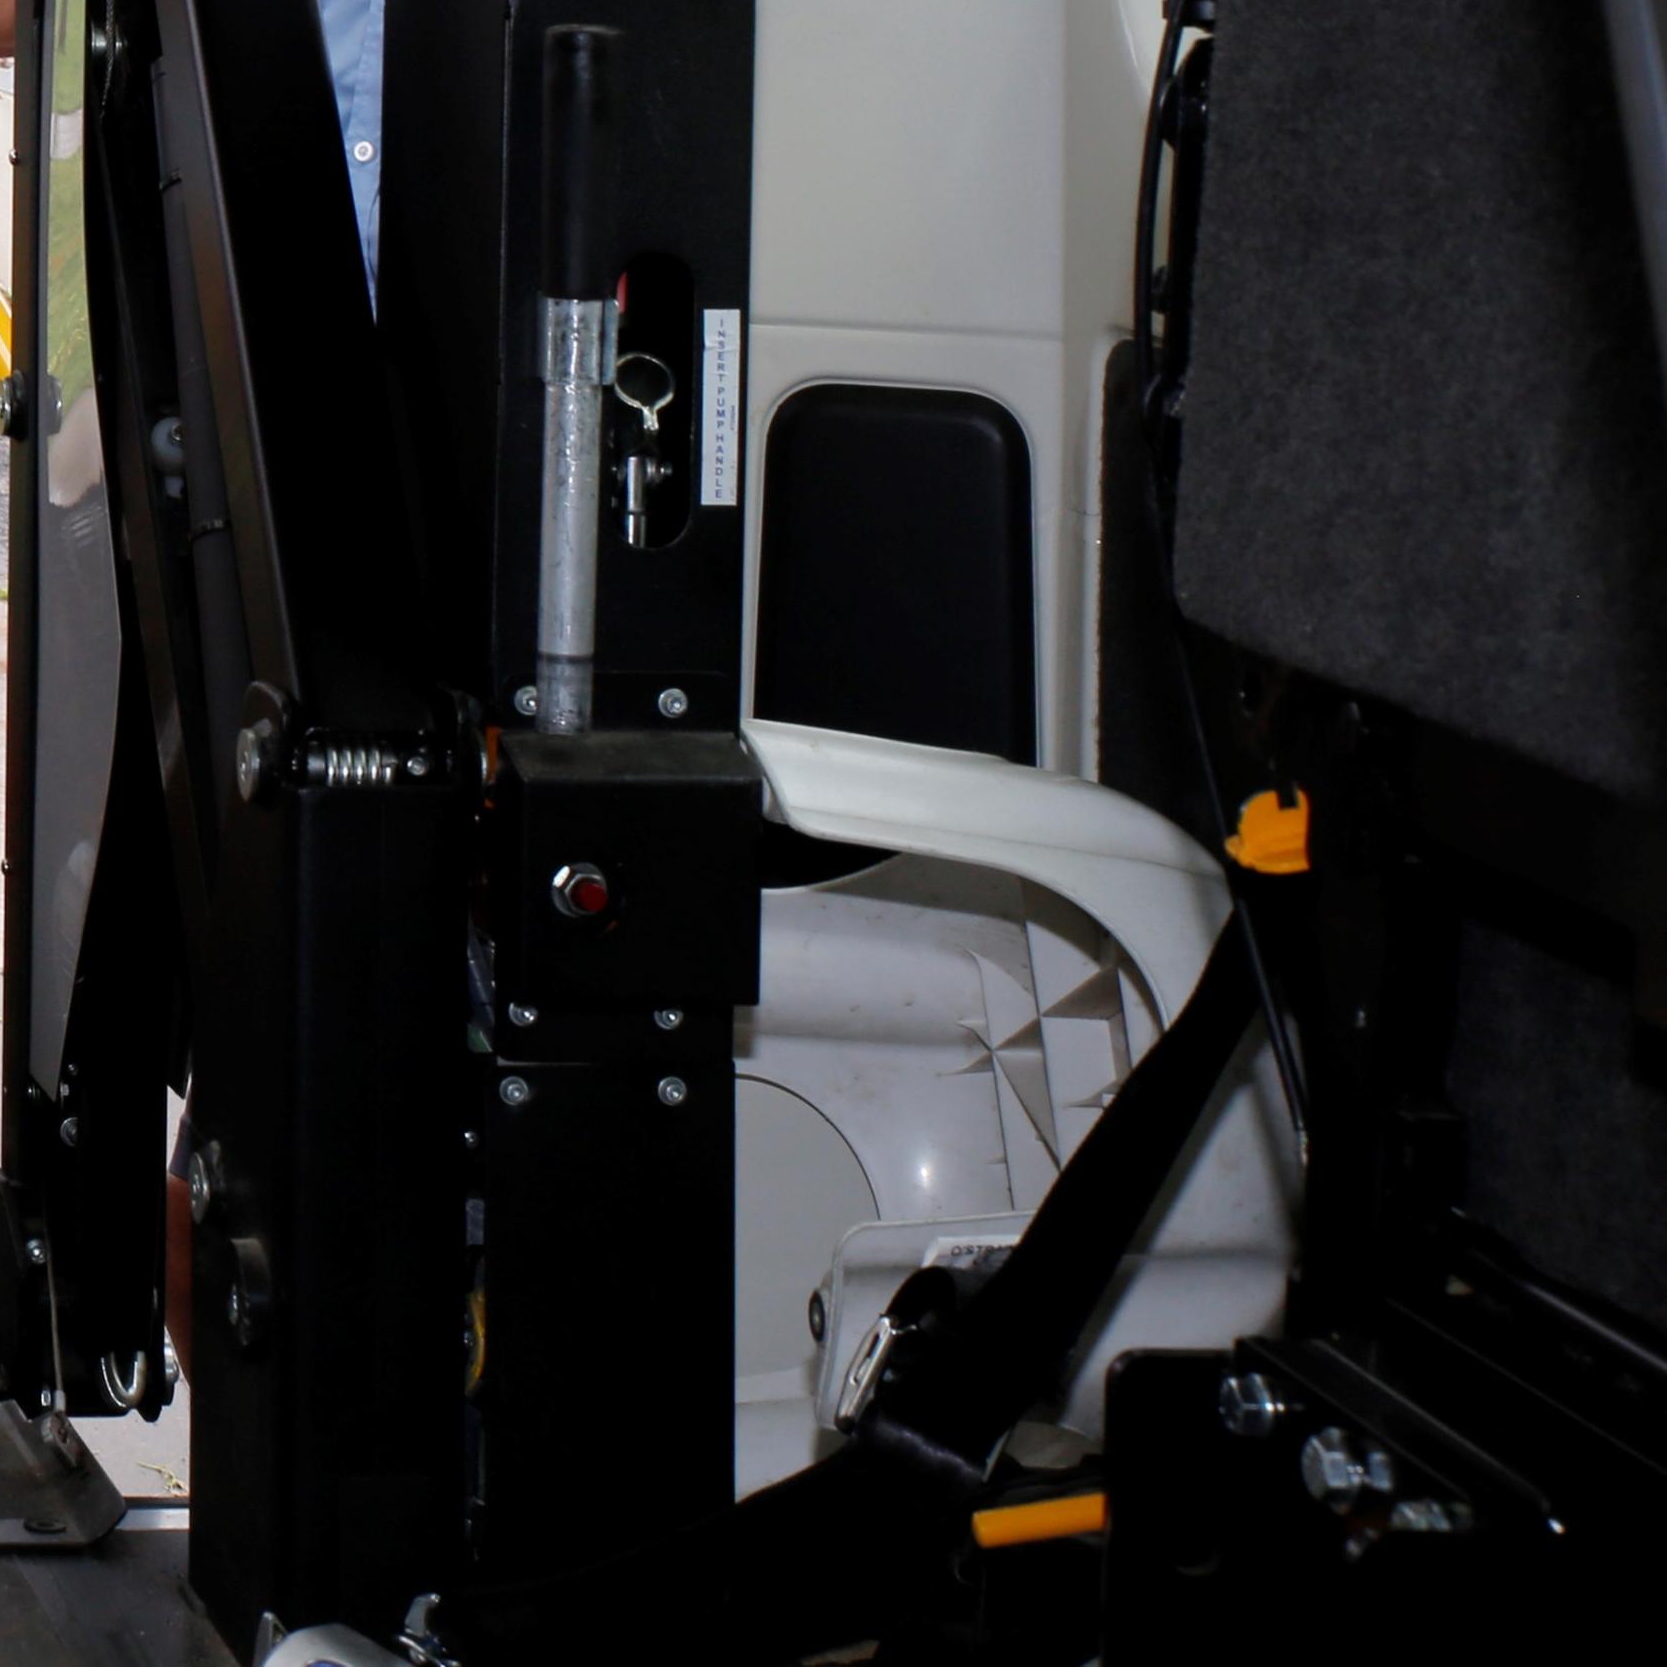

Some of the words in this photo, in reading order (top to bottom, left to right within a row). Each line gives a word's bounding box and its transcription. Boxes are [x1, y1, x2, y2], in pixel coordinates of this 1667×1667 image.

[716, 318, 726, 382] INSERT
[716, 387, 726, 429] PUMP
[714, 434, 724, 499] HANDLE
